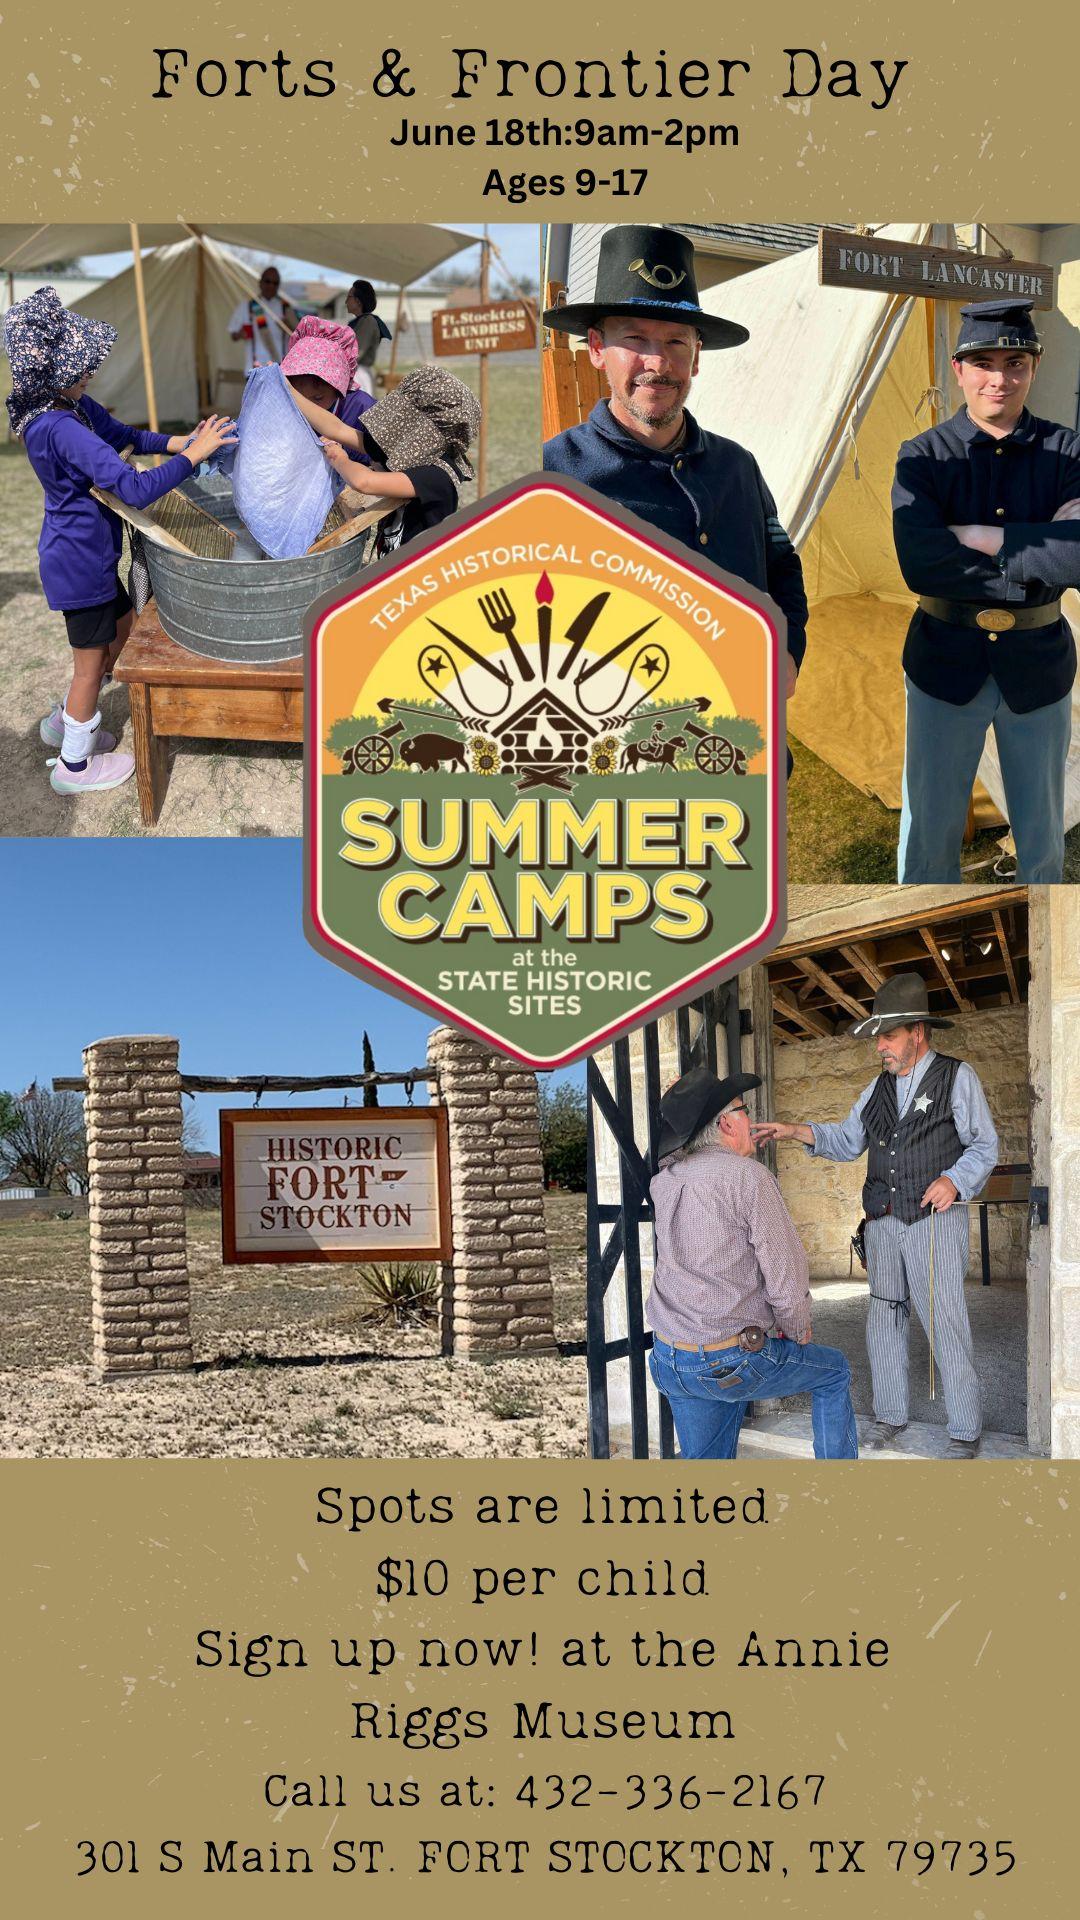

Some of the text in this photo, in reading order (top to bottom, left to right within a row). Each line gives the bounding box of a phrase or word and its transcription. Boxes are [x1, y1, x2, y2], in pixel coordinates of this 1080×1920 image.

[151, 48, 909, 110] Forts & Frontier Day
[389, 117, 739, 154] June 18th:9am-2pm
[482, 168, 648, 204] Ages 9-17
[837, 248, 1043, 296] FORT LANCASTER
[441, 320, 526, 340] LAUNDRESS
[464, 336, 500, 350] UNIT
[369, 543, 726, 642] TEXAS HISTORICAL COMMISSION
[338, 797, 751, 869] SUMMER
[377, 870, 711, 942] CAMPS
[512, 947, 578, 967] at the
[437, 970, 653, 992] STATE HISTORIC
[507, 994, 582, 1016] SITES
[267, 1136, 403, 1162] HISTORIC
[267, 1164, 375, 1201] FORT
[260, 1203, 412, 1230] STOCKTON
[316, 1486, 454, 1533] Spots
[476, 1495, 558, 1525] are
[376, 1555, 449, 1603] $10
[471, 1567, 556, 1605] per
[196, 1629, 889, 1678] Sign up now! at the Annie
[350, 1701, 736, 1750] Riggs Museum
[264, 1774, 826, 1811] Call us at: 432-336-2167
[77, 1840, 1017, 1880] 301 S Main ST. FORT STOCKTON, TX 79735
